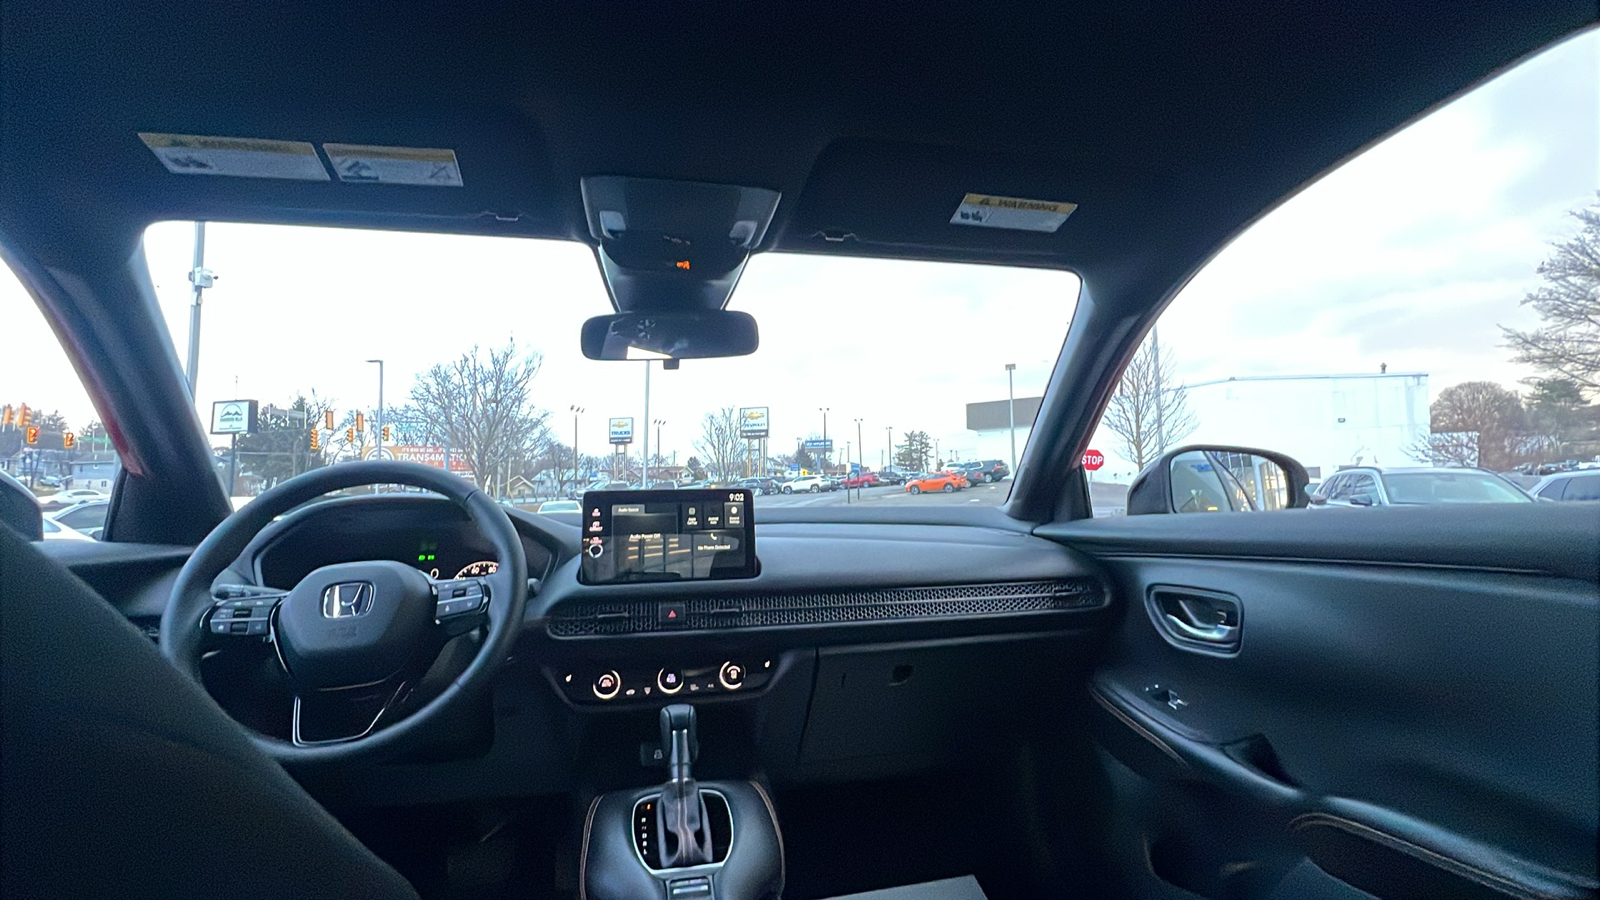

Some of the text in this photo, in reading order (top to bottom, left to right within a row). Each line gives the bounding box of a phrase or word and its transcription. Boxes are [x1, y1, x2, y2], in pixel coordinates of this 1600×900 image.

[998, 199, 1059, 212] WARNING
[1081, 454, 1103, 466] STOP
[729, 492, 744, 502] 9:02
[471, 566, 480, 575] 60
